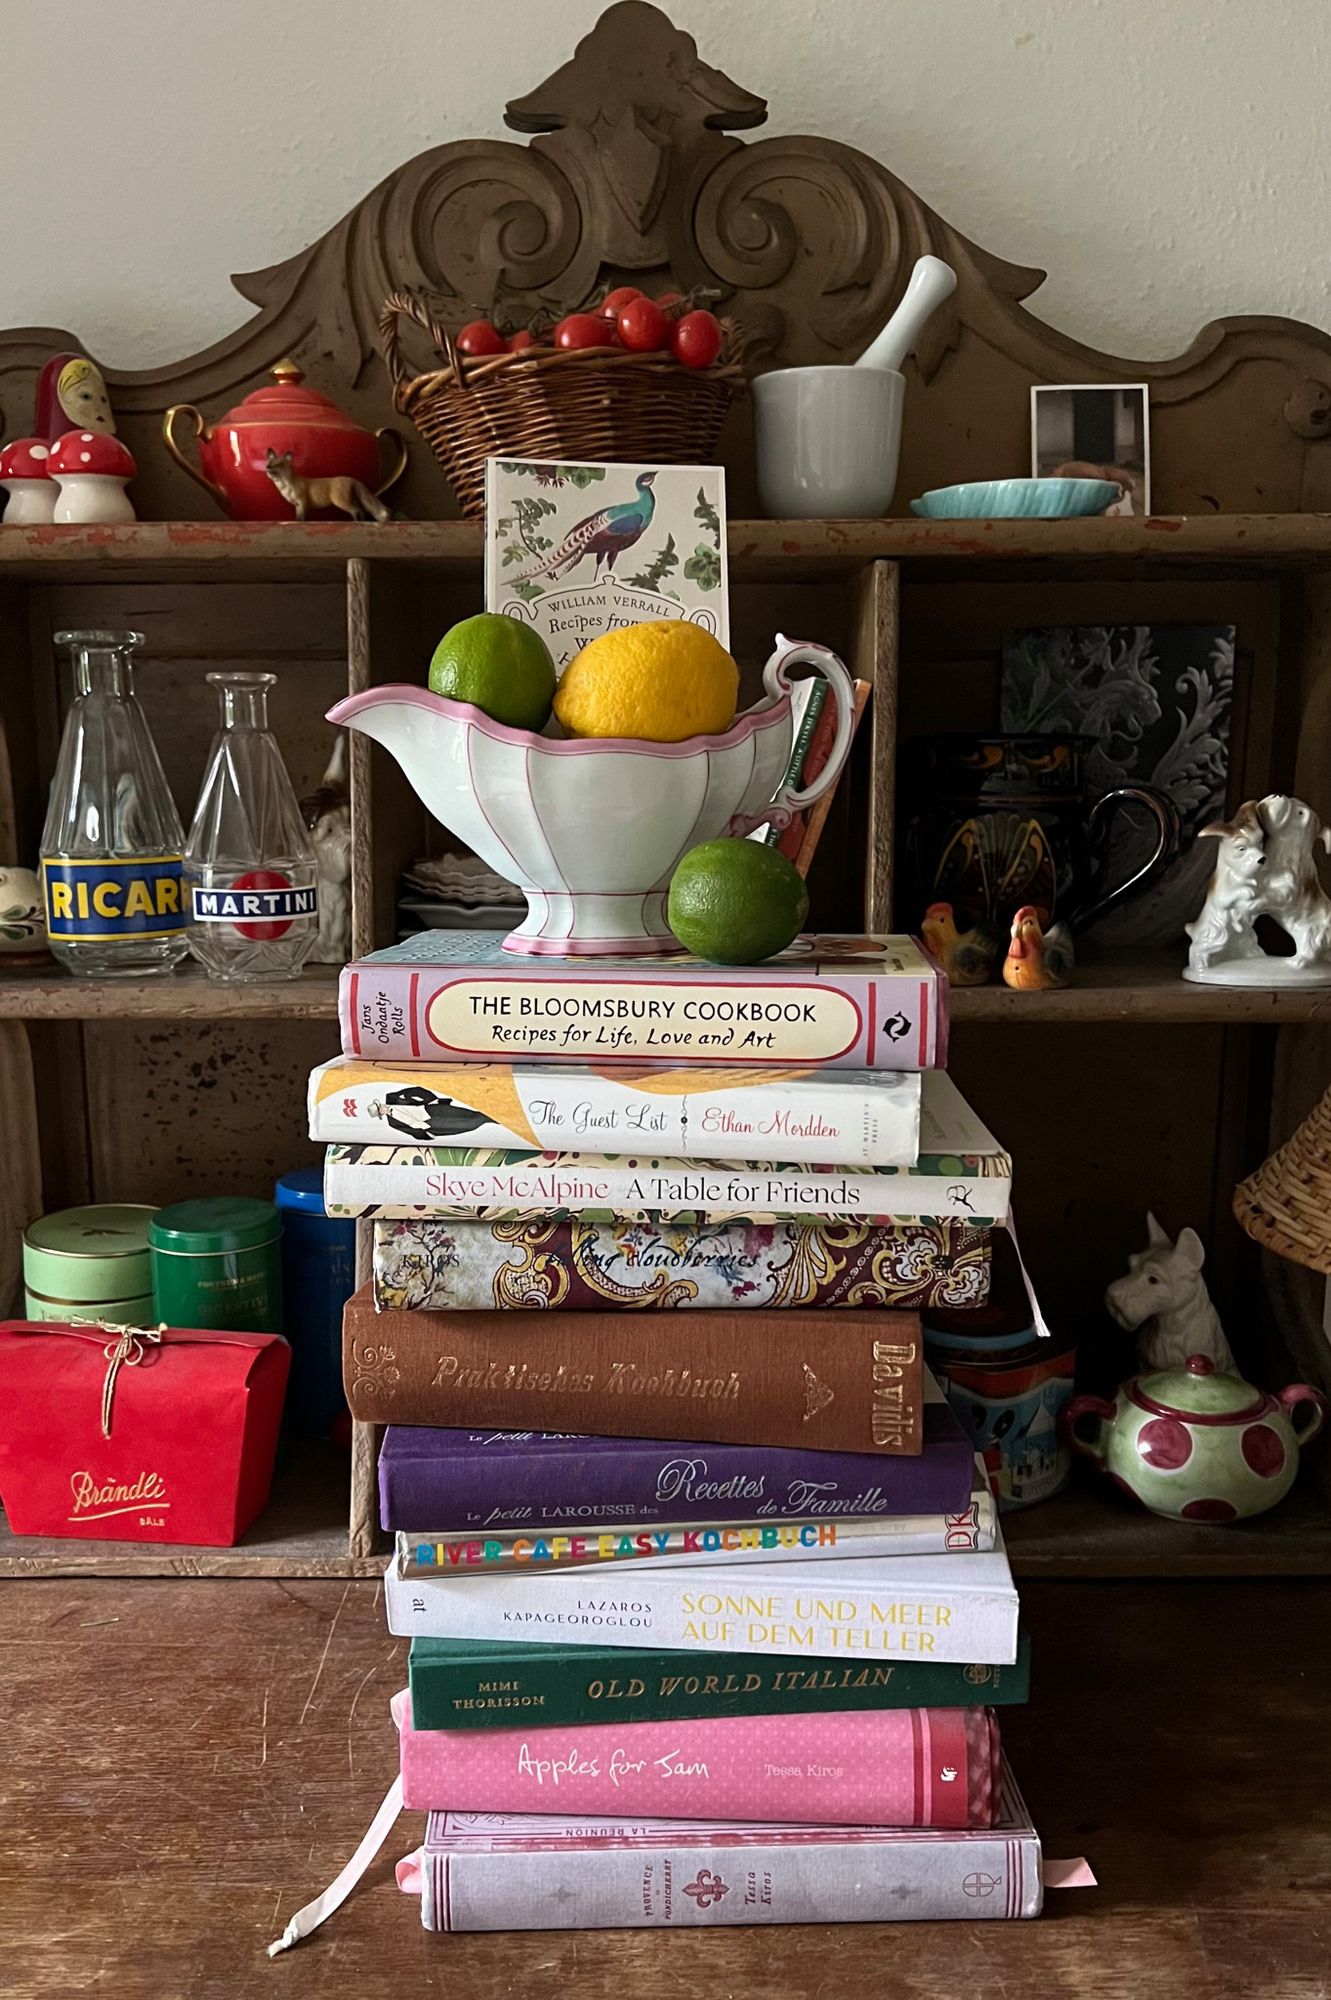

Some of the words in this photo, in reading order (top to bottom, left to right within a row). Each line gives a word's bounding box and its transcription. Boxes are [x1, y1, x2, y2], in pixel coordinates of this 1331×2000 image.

[547, 596, 607, 612] WILLIAM
[613, 596, 670, 617] VERRALL
[549, 614, 603, 634] Recipes
[790, 755, 801, 779] LITTLE
[201, 891, 315, 915] MARTINI
[361, 1004, 376, 1034] Jans
[377, 990, 391, 1044] Ondaatje
[392, 1006, 405, 1036] Rolls
[469, 996, 511, 1015] THE
[520, 997, 675, 1019] BLOOMSBURY
[683, 1001, 816, 1022] COOKBOOK
[492, 1024, 557, 1046] Recipes
[559, 1023, 592, 1047] for
[595, 1024, 638, 1048] Life,
[646, 1028, 693, 1046] Love
[698, 1027, 735, 1047] and
[737, 1030, 777, 1048] Art
[528, 1100, 565, 1126] The
[571, 1101, 619, 1134] Guest
[625, 1100, 669, 1132] List
[701, 1106, 755, 1134] Ethan
[757, 1110, 840, 1138] Mordden
[426, 1172, 487, 1201] Skye
[492, 1173, 610, 1204] McAlpine
[626, 1178, 647, 1200] A
[650, 1177, 723, 1202] Table
[727, 1177, 761, 1202] for
[766, 1179, 860, 1204] Friends
[431, 1356, 595, 1393] Praktisches
[601, 1362, 740, 1398] Kochbuch
[71, 1471, 166, 1513] Brändli
[656, 1459, 765, 1502] Recettes
[757, 1498, 778, 1515] de
[782, 1479, 888, 1514] Famille
[467, 1511, 481, 1521] Le
[483, 1505, 535, 1526] petit
[541, 1504, 636, 1518] LAROUSSE
[639, 1504, 660, 1515] des
[946, 1505, 977, 1550] DK
[416, 1540, 501, 1566] RIVER
[512, 1535, 588, 1562] CAFE
[598, 1531, 671, 1558] EASY
[682, 1524, 837, 1553] KOCHBUCH
[412, 1598, 428, 1613] at
[504, 1611, 653, 1628] KAPAGEOROGLOU
[577, 1600, 653, 1613] LAZAROS
[682, 1592, 784, 1619] SONNE
[795, 1598, 857, 1622] UND
[870, 1602, 952, 1627] MEER
[681, 1620, 739, 1642] AUF
[749, 1623, 814, 1648] DEM
[826, 1627, 936, 1653] TELLER
[478, 1681, 519, 1693] MIMI
[588, 1679, 645, 1699] OLD
[659, 1673, 762, 1697] WORLD
[772, 1667, 896, 1691] ITALIAN
[452, 1695, 545, 1710] THORISSON
[518, 1743, 601, 1785] Apples
[608, 1748, 647, 1787] for
[653, 1750, 710, 1779] Jam
[764, 1763, 802, 1777] Tessa
[807, 1763, 844, 1777] Kiros
[631, 1827, 646, 1835] LA
[643, 1864, 654, 1917] PROVENCE
[664, 1859, 672, 1920] PONDICHERRY
[745, 1872, 756, 1906] Tessa
[760, 1871, 772, 1906] Kiros
